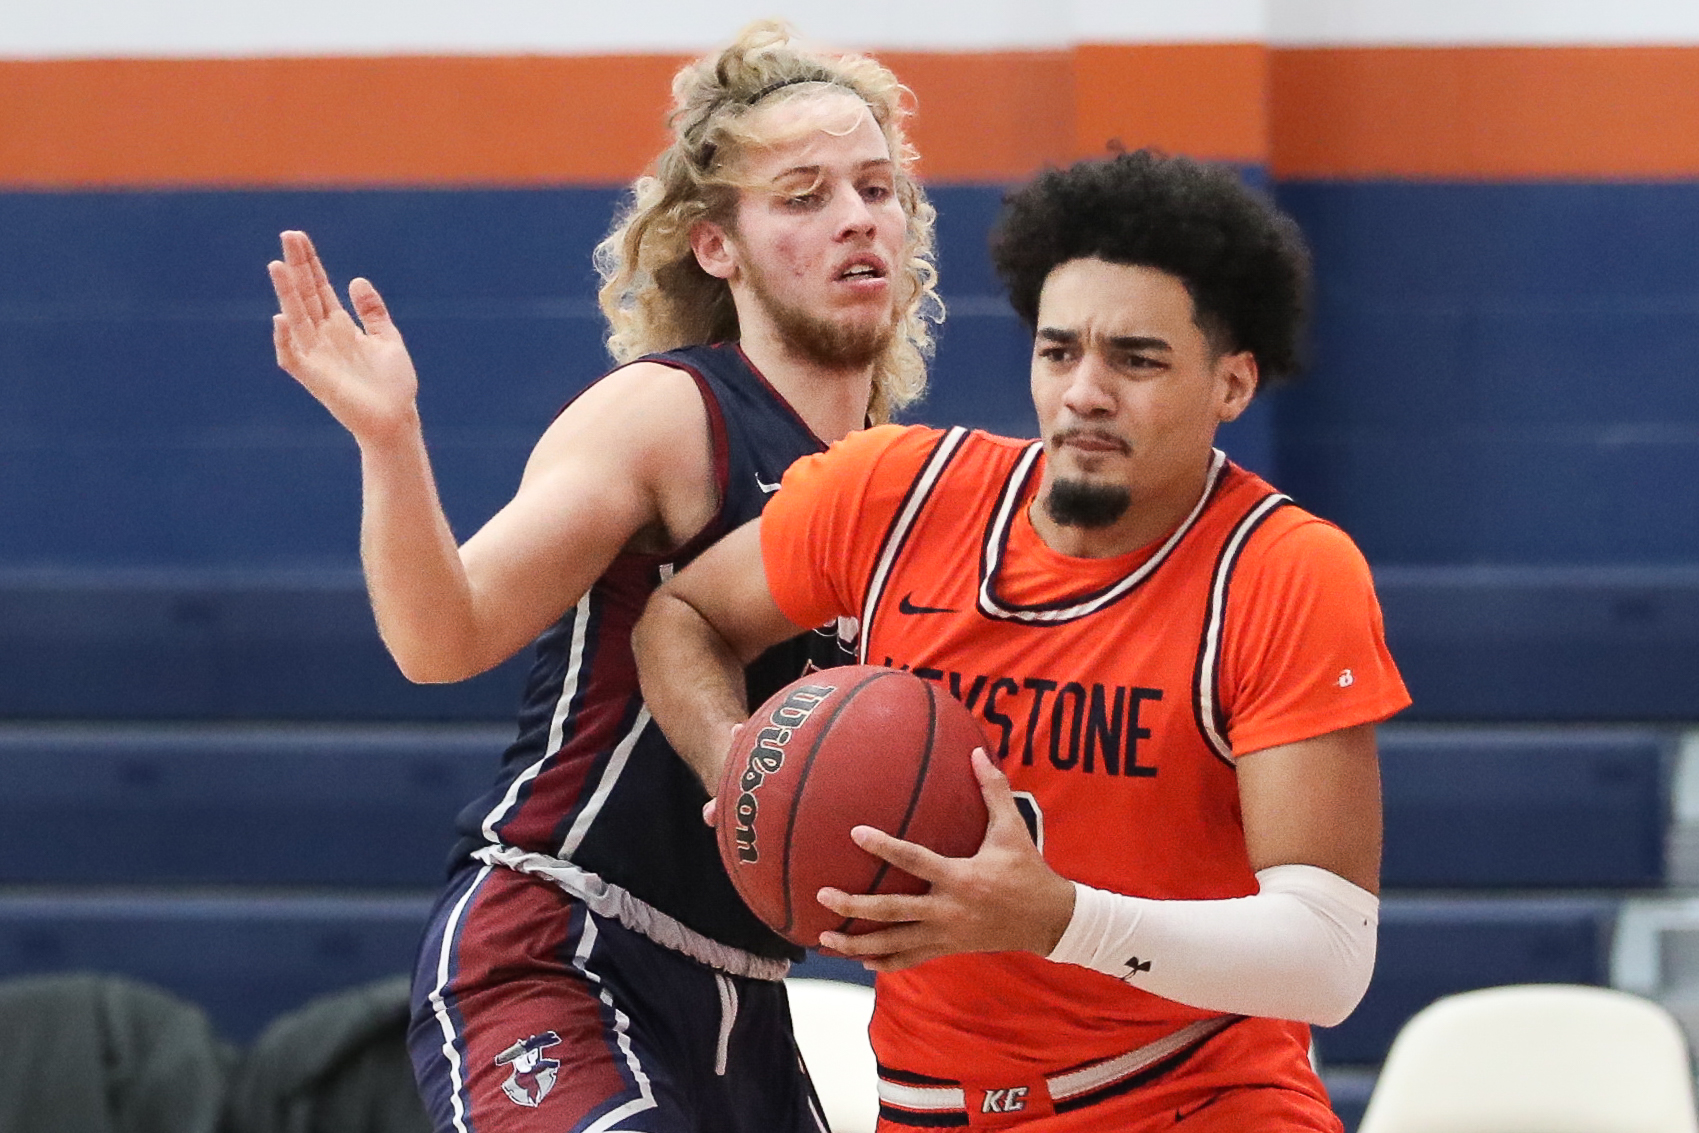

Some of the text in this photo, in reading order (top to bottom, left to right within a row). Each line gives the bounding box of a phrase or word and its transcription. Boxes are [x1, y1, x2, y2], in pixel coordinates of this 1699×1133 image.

[735, 684, 837, 865] Wilson
[885, 657, 1163, 777] STONE
[982, 1086, 1028, 1113] KC
